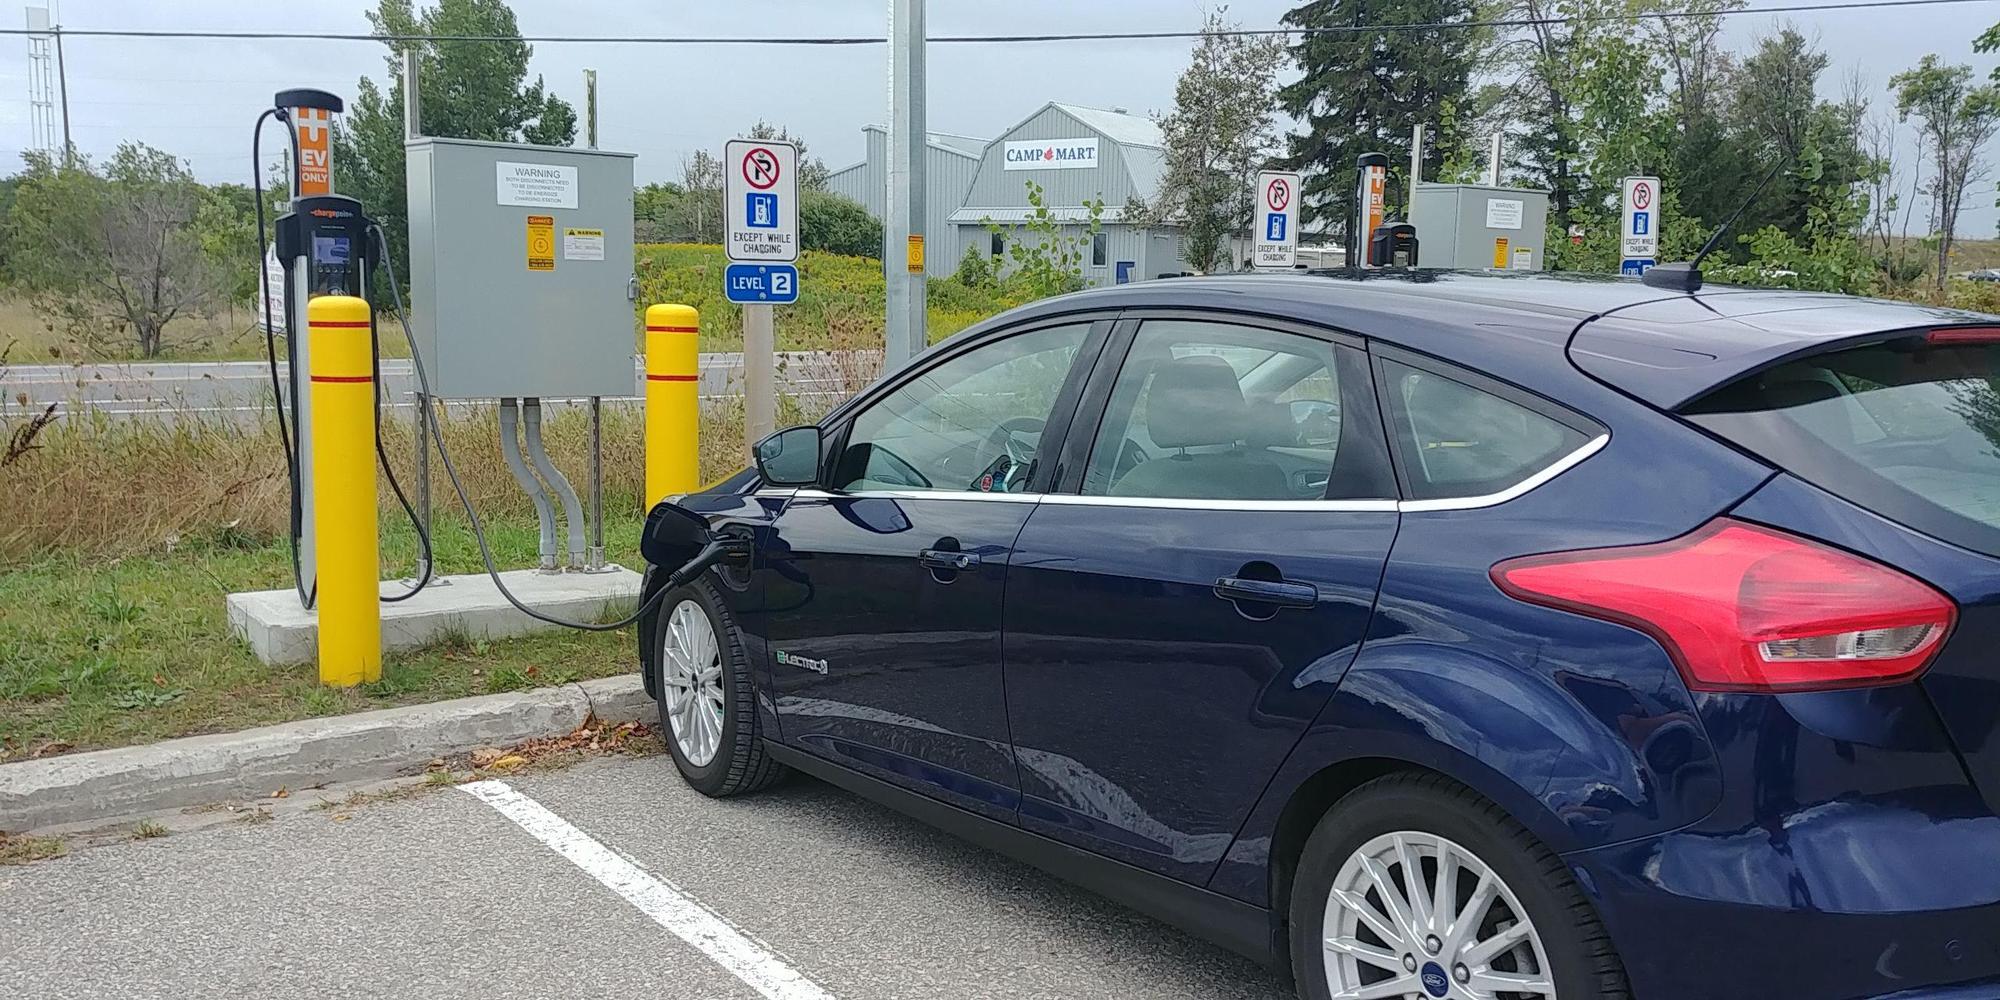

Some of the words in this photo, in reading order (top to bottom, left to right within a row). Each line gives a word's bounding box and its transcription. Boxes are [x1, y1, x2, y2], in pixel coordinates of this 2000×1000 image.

[301, 149, 327, 166] EV
[1006, 148, 1043, 162] CAMP
[1055, 147, 1095, 160] MART
[302, 173, 328, 183] ONLY
[515, 168, 561, 178] WARNING
[734, 232, 763, 242] EXCEPT
[768, 234, 791, 243] WHILE
[1258, 244, 1276, 252] EXCEPT
[733, 277, 765, 290] LEVEL
[776, 276, 788, 290] 2
